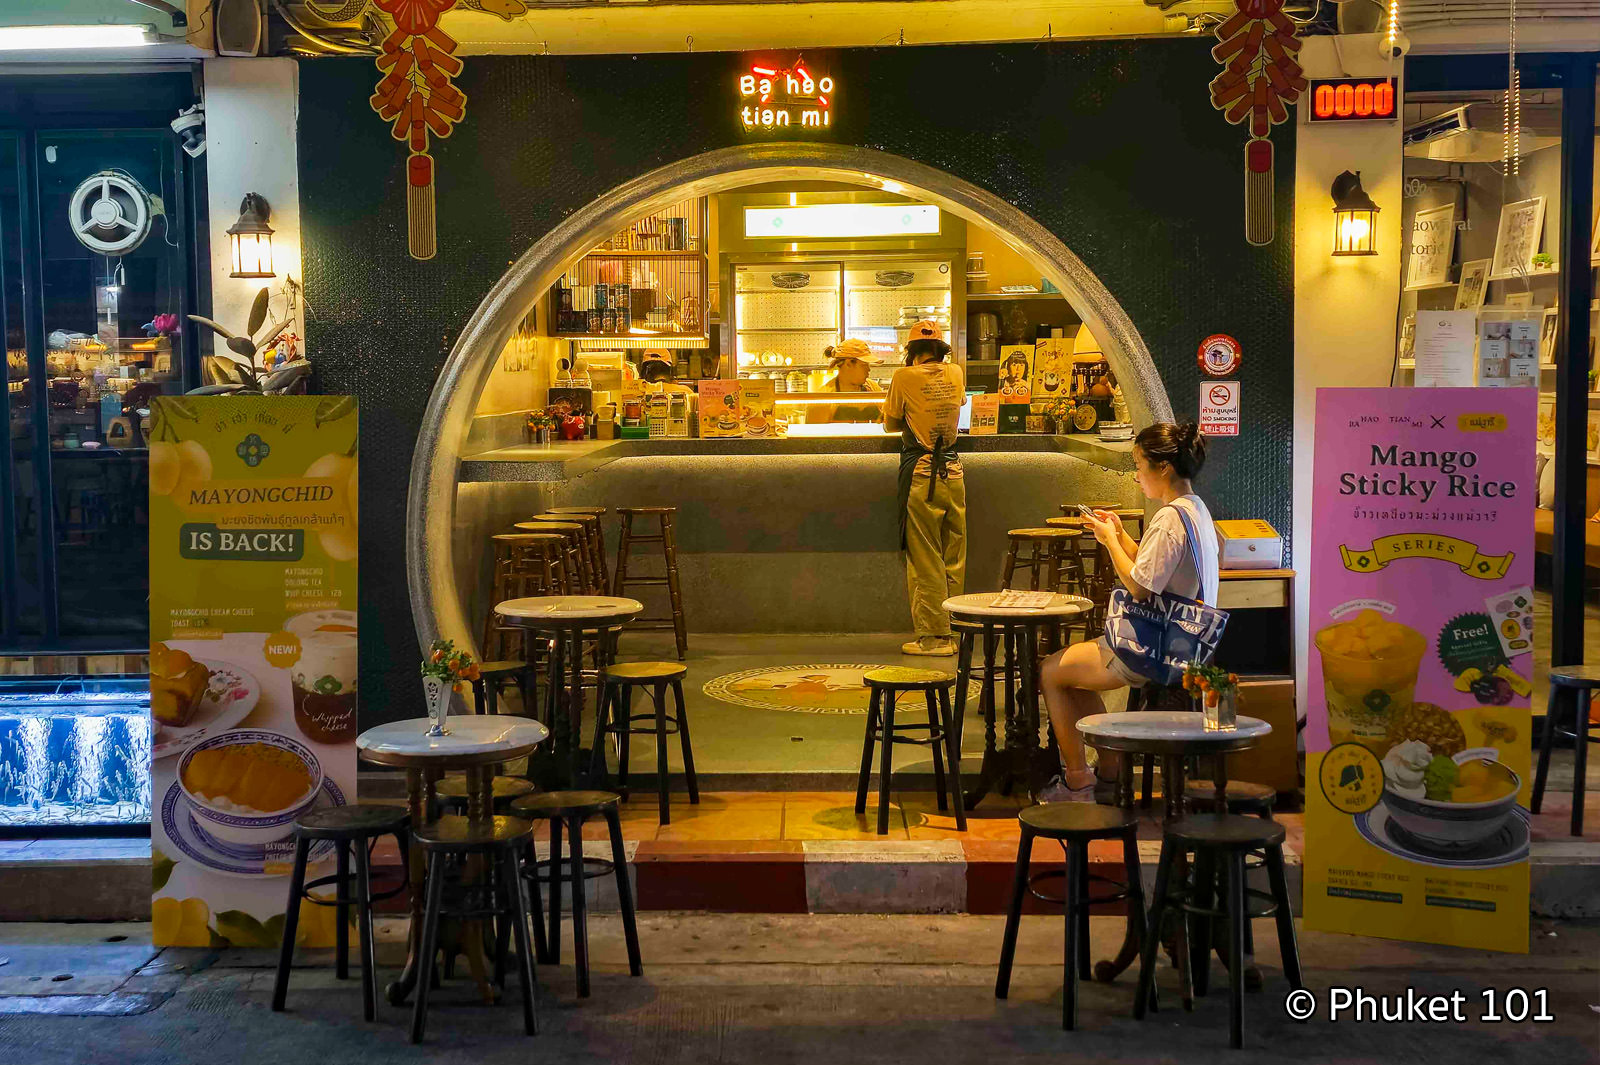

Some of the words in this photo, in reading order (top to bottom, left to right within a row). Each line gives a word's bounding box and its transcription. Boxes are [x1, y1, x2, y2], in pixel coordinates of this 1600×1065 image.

[1361, 415, 1379, 423] HAO
[1389, 415, 1411, 423] TIAN
[1370, 444, 1477, 474] Mango
[189, 485, 334, 505] MAYONGCHID
[1339, 472, 1437, 503] Sticky
[1447, 474, 1516, 499] Rice
[189, 531, 212, 551] IS
[219, 532, 294, 553] BACK!
[1392, 539, 1456, 555] SERIES
[1453, 623, 1489, 641] Free!
[268, 644, 297, 655] NEW!
